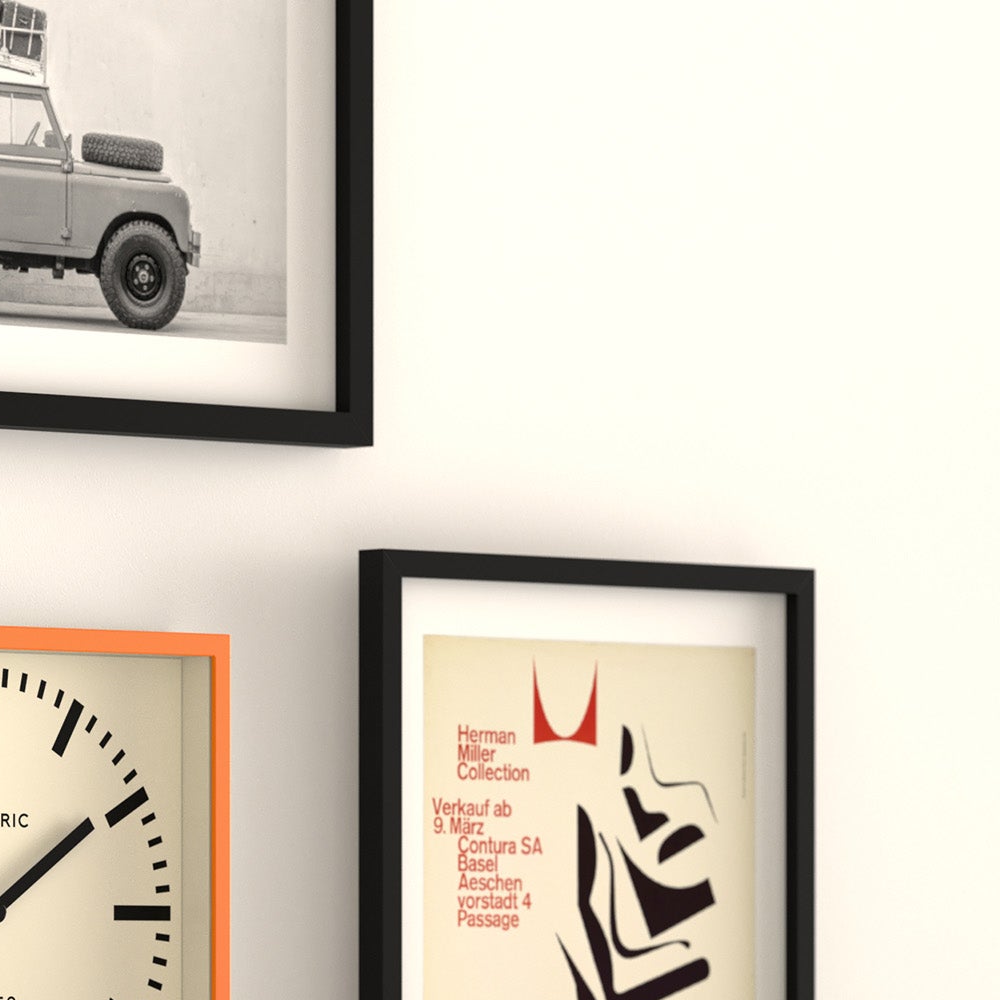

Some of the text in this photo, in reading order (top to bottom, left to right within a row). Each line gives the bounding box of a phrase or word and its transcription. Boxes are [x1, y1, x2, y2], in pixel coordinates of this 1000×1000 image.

[457, 724, 517, 745] Herman
[457, 744, 497, 763] Miller
[456, 763, 531, 782] Collection
[432, 798, 513, 818] Verkauf ab
[433, 817, 485, 836] 9. März
[457, 836, 544, 856] Contura SA
[457, 855, 499, 873] Basel
[457, 873, 523, 892] Aeschen
[457, 891, 533, 911] vorstadt 4
[457, 910, 520, 931] Passage
